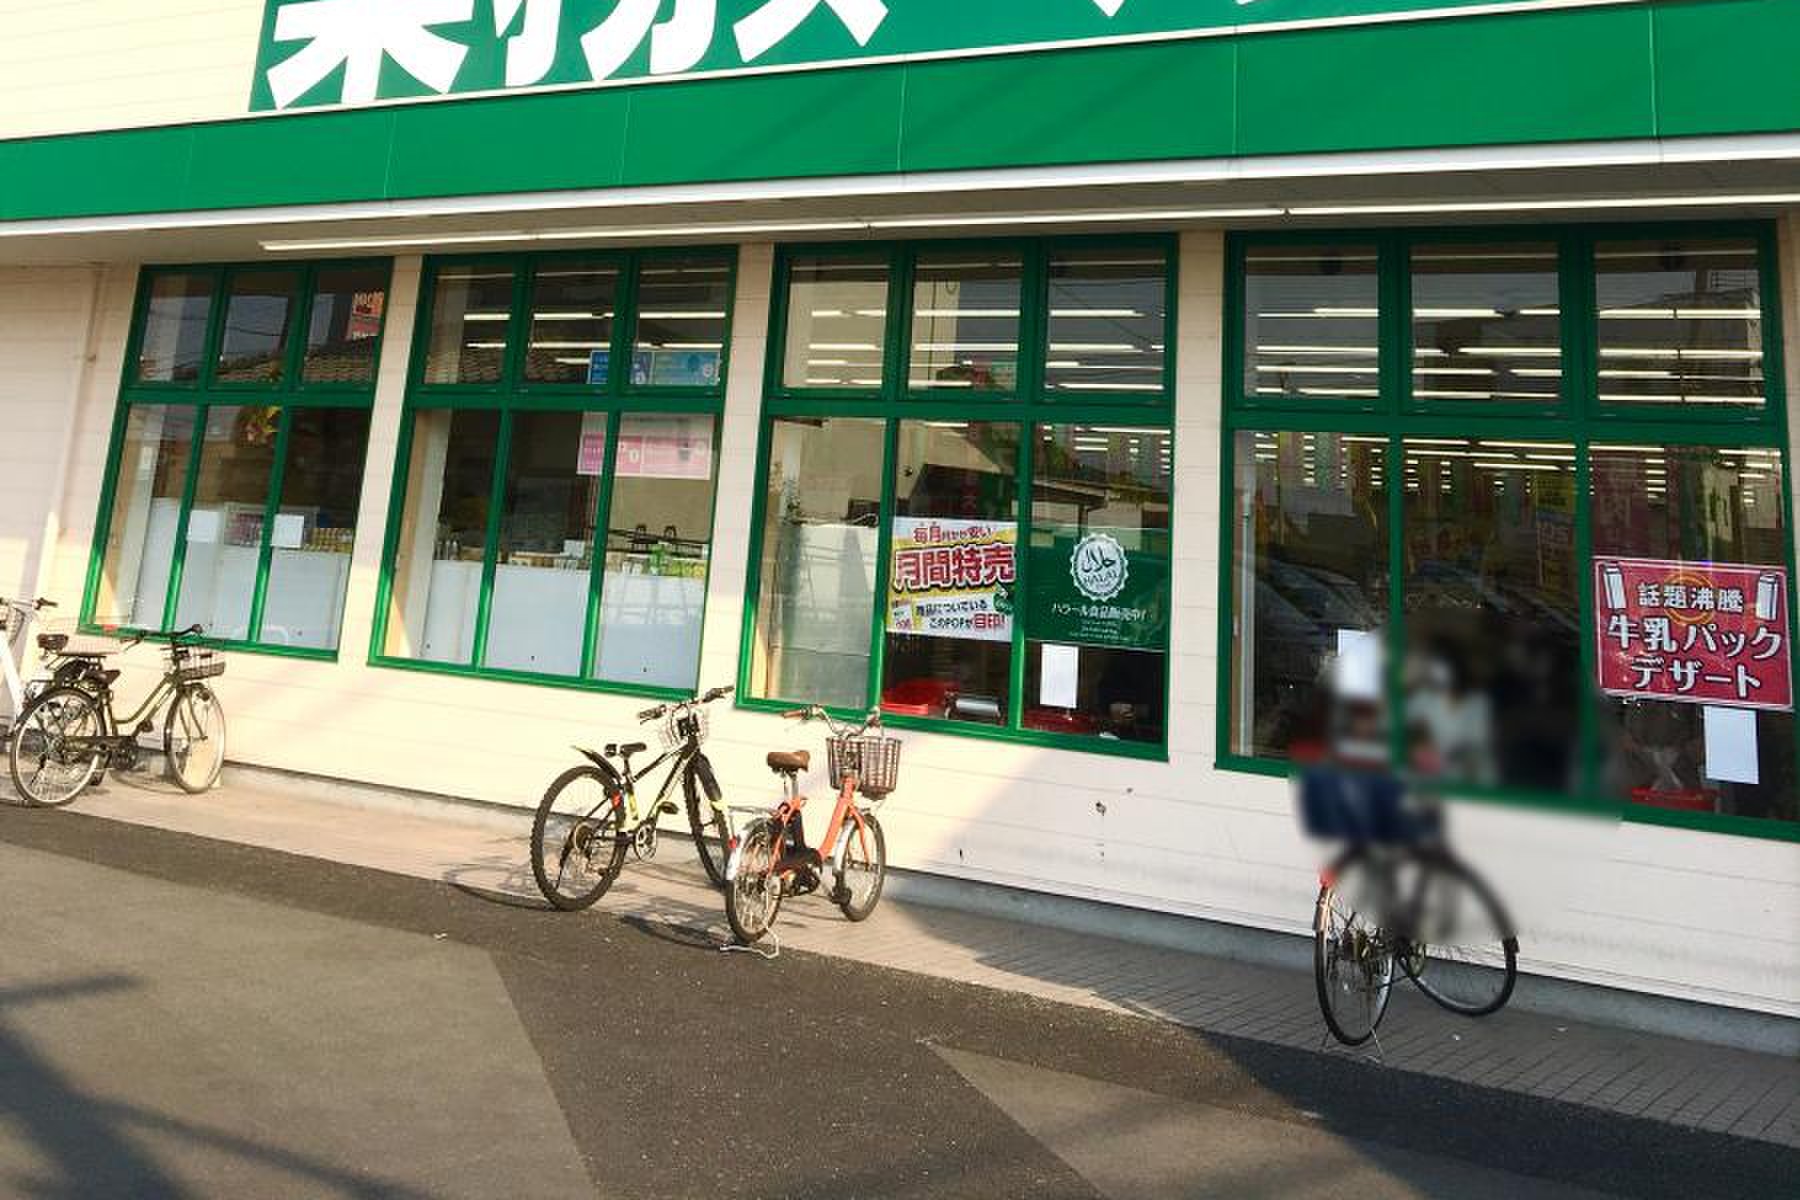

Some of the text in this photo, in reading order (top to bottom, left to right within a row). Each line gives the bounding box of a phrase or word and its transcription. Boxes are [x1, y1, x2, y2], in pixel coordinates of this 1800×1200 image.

[894, 542, 1016, 590] 月間特売
[1606, 614, 1782, 661] 牛乳パック
[1631, 655, 1761, 699] デザート
